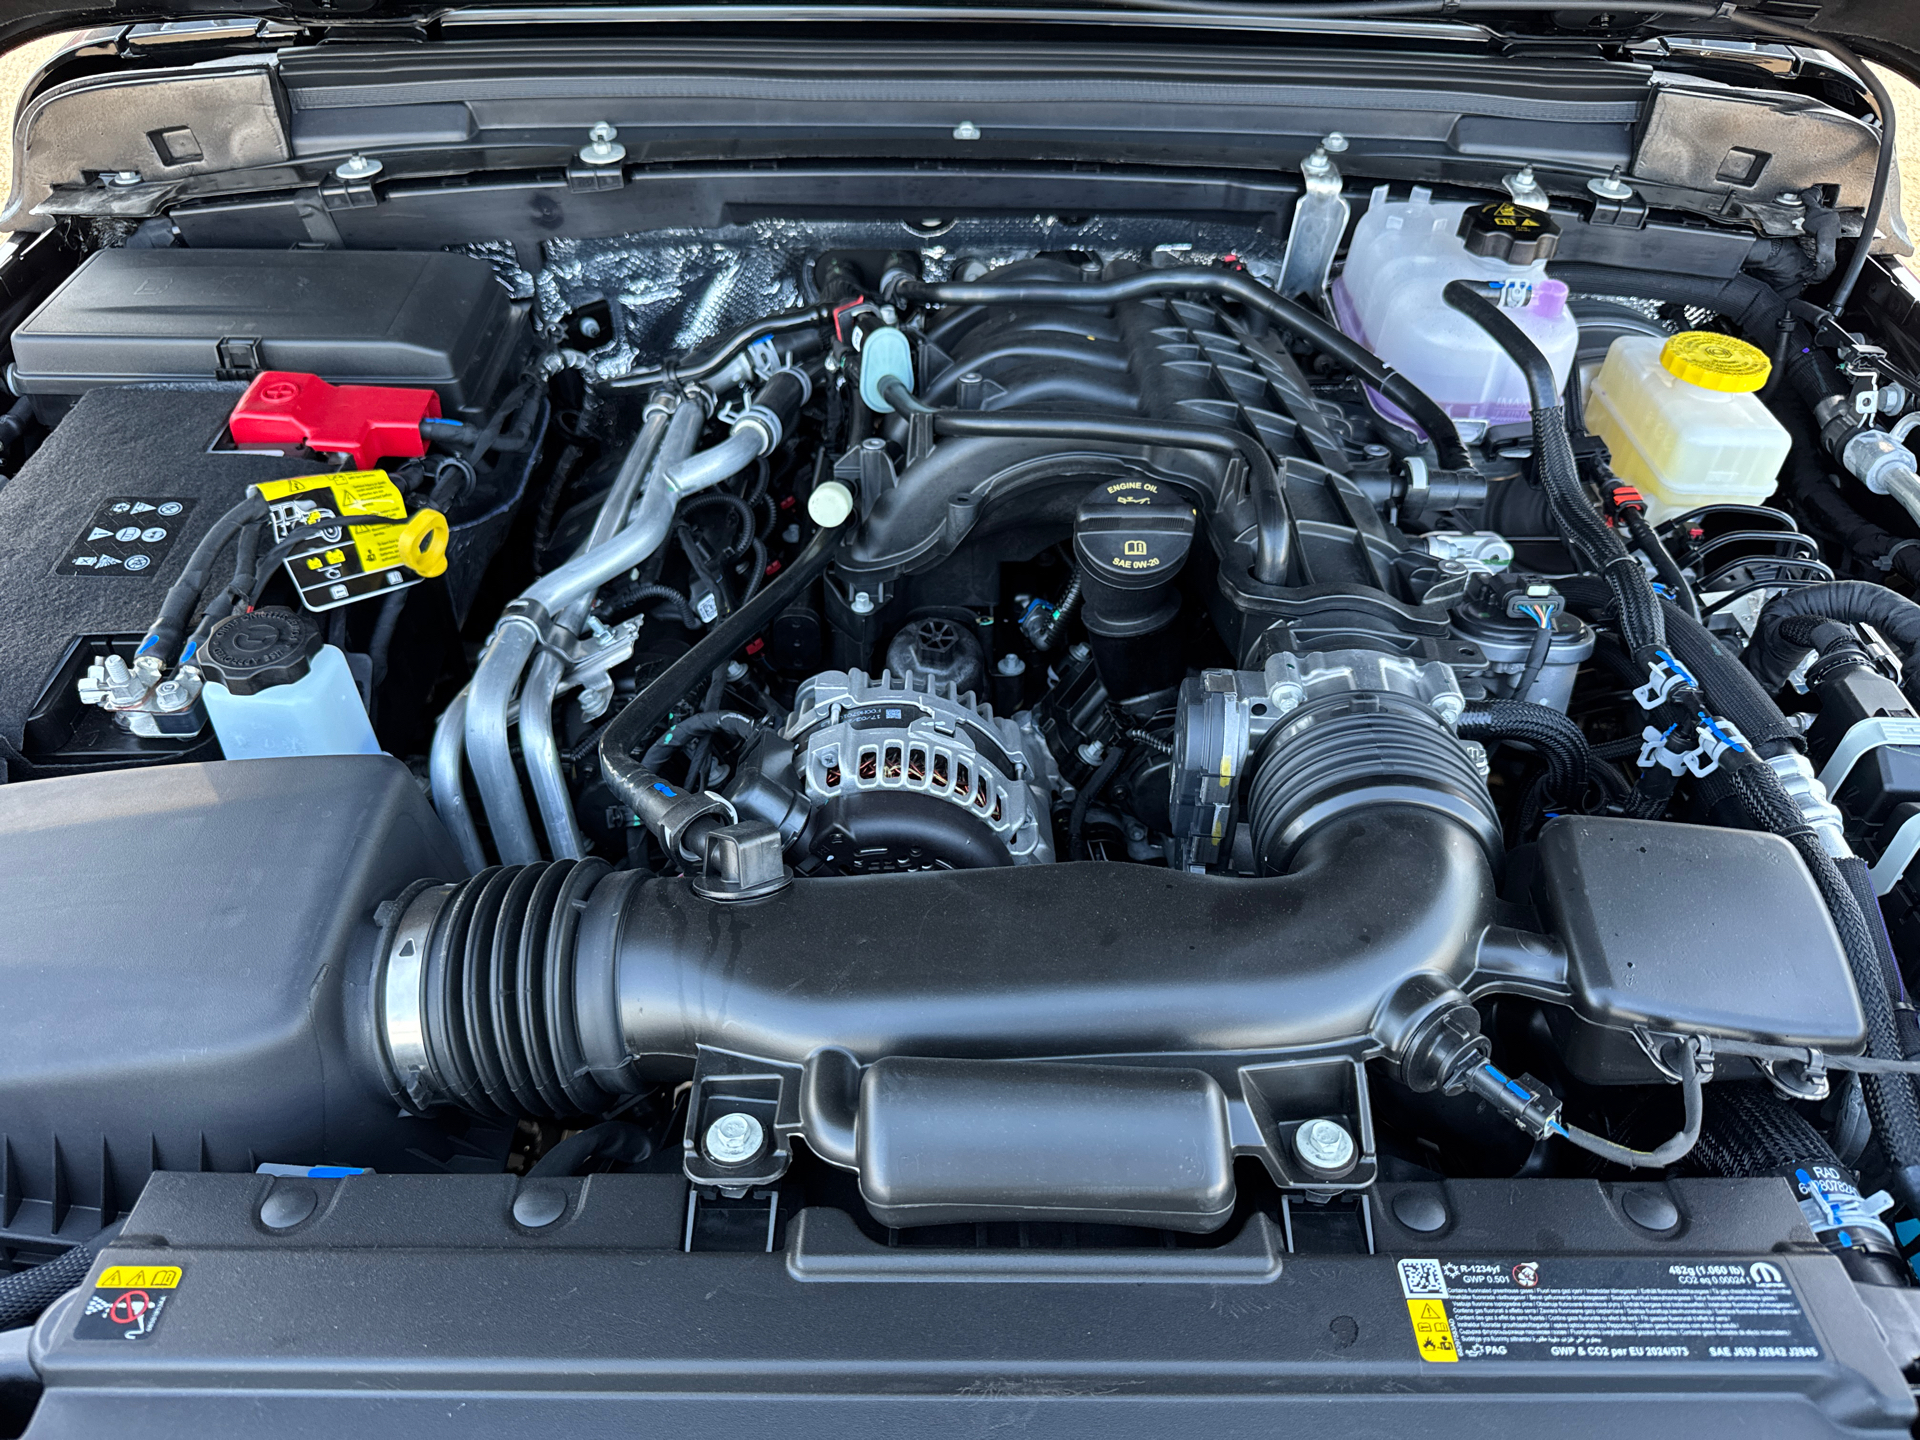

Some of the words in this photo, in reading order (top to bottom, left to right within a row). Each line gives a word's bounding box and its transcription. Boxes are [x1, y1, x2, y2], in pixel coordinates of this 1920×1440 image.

[1107, 482, 1142, 494] ENGINE
[1144, 482, 1158, 494] OIL
[1112, 558, 1132, 568] SAE
[1133, 558, 1160, 568] 0W-20
[1812, 1166, 1840, 1180] RAD
[1463, 1275, 1485, 1283] GWP
[1486, 1275, 1510, 1283] 0.501
[1679, 1276, 1699, 1284] CO2
[1485, 1346, 1507, 1355] PAG
[1551, 1346, 1576, 1356] GWP
[1577, 1346, 1586, 1356] &
[1587, 1346, 1610, 1356] CO2
[1611, 1348, 1627, 1358] per
[1628, 1346, 1644, 1356] EU
[1709, 1346, 1732, 1357] SAE
